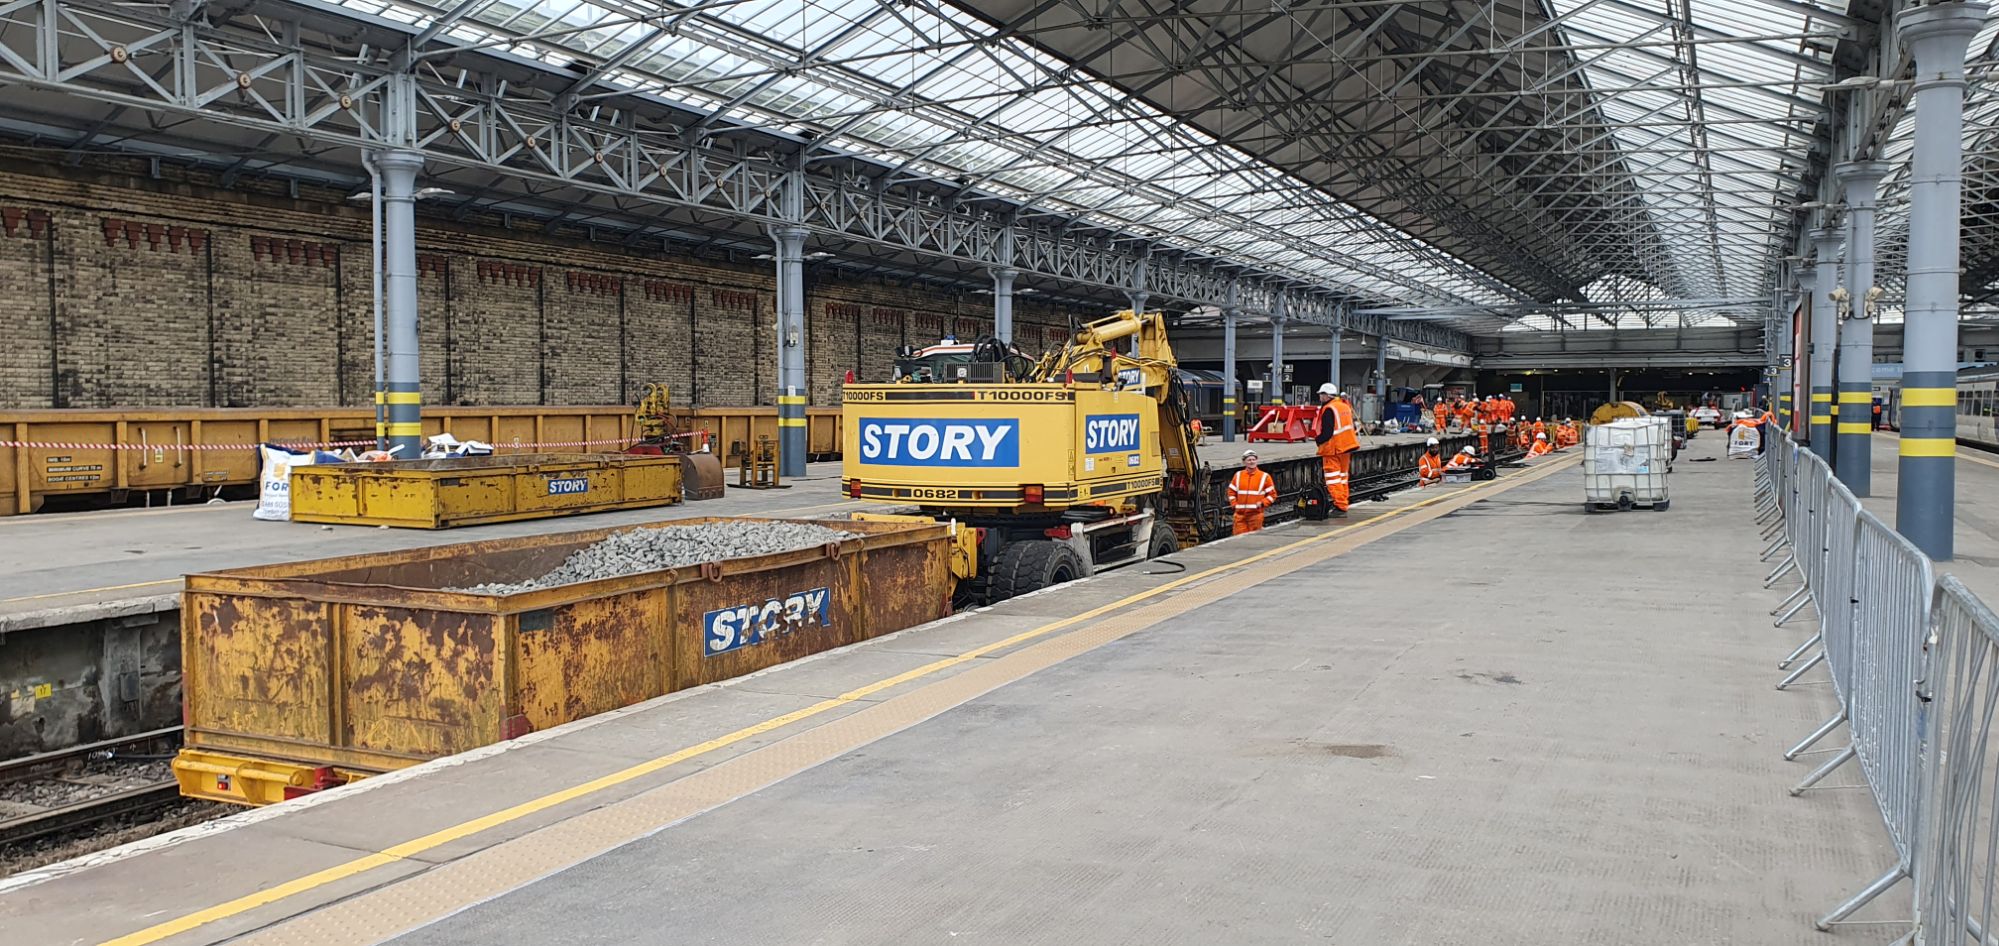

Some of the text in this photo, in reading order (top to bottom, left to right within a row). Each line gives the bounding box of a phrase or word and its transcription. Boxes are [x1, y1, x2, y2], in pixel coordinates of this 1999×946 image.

[1783, 359, 1791, 367] 3
[977, 391, 1067, 400] T10000FS
[1087, 419, 1138, 449] STORY
[862, 423, 1012, 460] STORY
[265, 481, 289, 492] FOR
[549, 480, 587, 493] STORY
[913, 489, 957, 499] 0682
